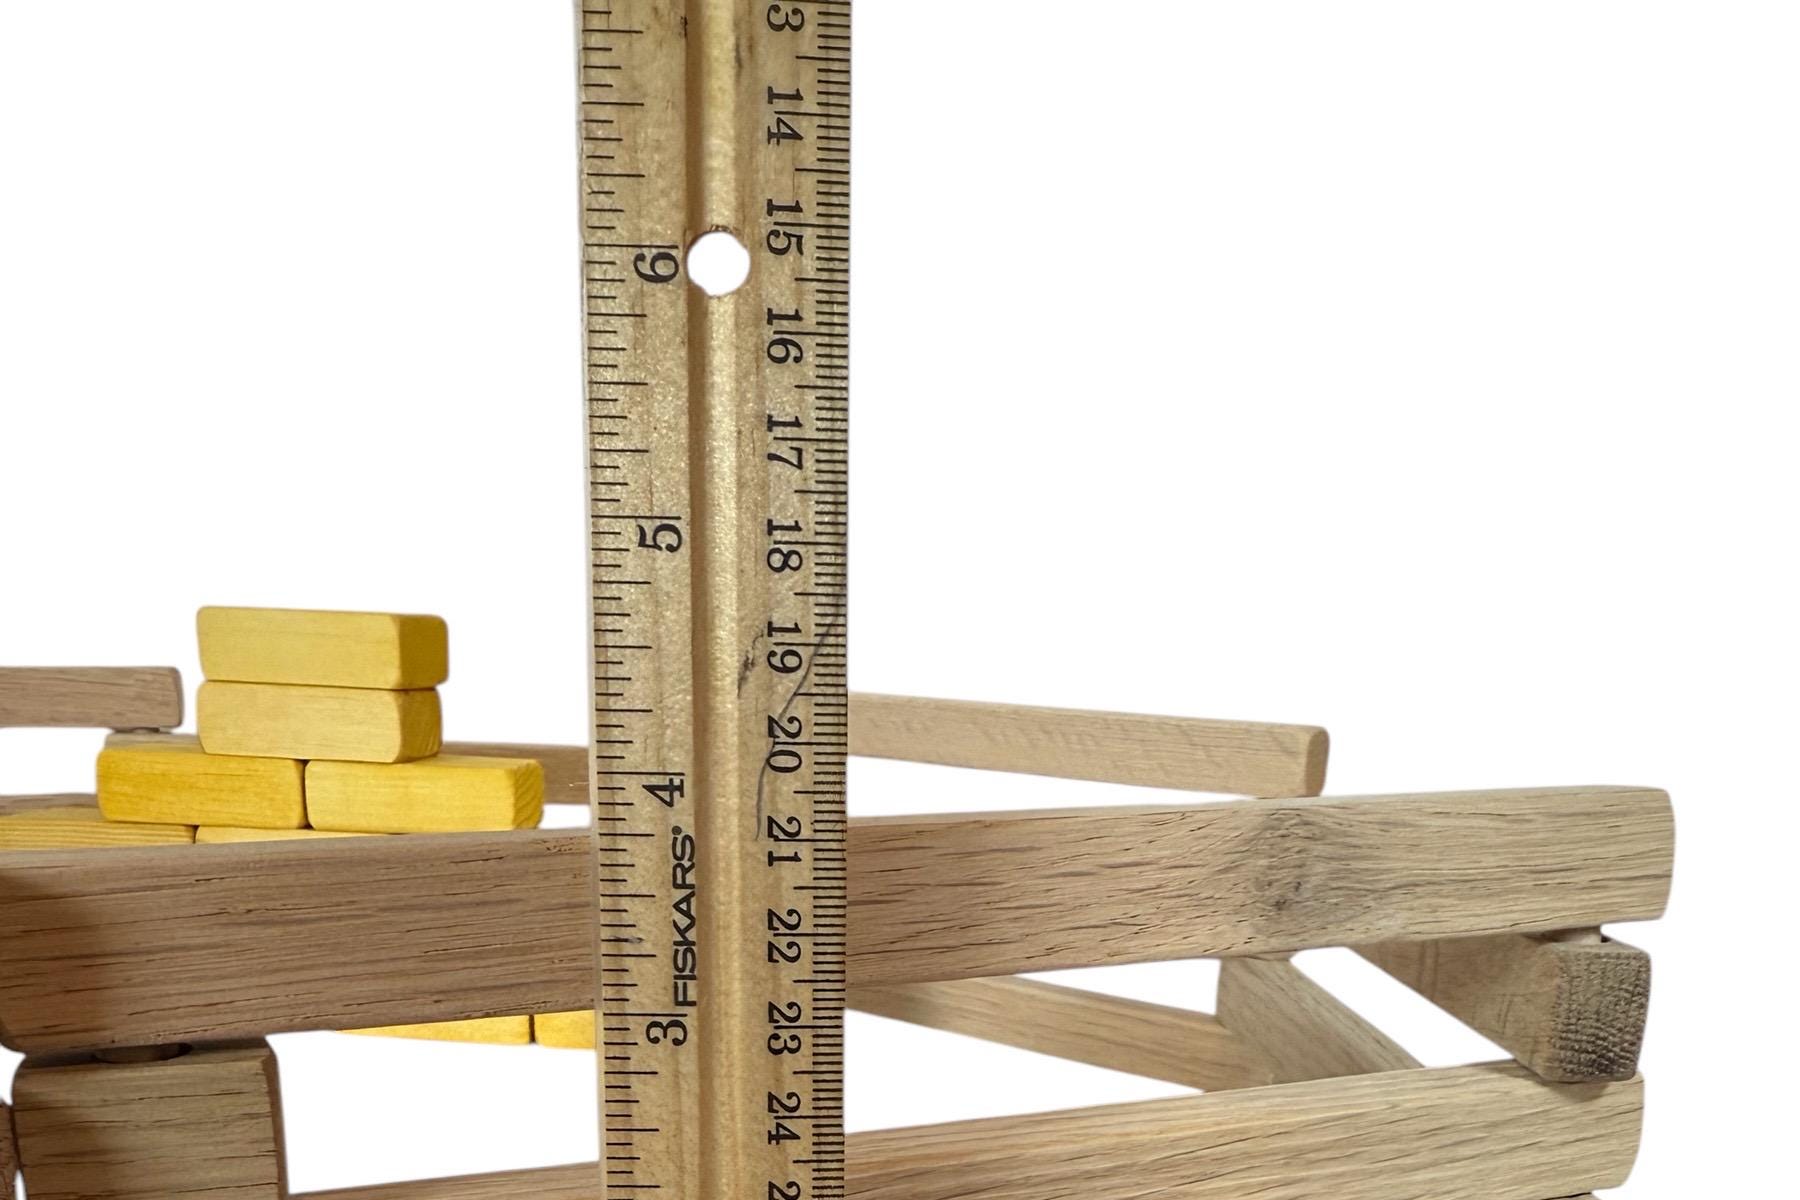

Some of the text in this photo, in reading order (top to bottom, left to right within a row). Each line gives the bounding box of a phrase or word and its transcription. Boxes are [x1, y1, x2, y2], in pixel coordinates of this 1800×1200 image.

[766, 3, 805, 32] 3
[767, 86, 804, 147] 14
[766, 198, 804, 256] 15
[633, 251, 680, 284] 6
[767, 307, 804, 364] 16
[767, 414, 803, 471] 17
[637, 523, 683, 553] 5
[767, 518, 803, 573] 18
[767, 620, 802, 674] 19
[766, 715, 802, 773] 20
[641, 778, 685, 808] 4
[767, 815, 802, 867] 21
[767, 908, 802, 963] 22
[645, 1019, 688, 1047] 3
[767, 1001, 802, 1056] 23
[767, 1091, 801, 1146] 24
